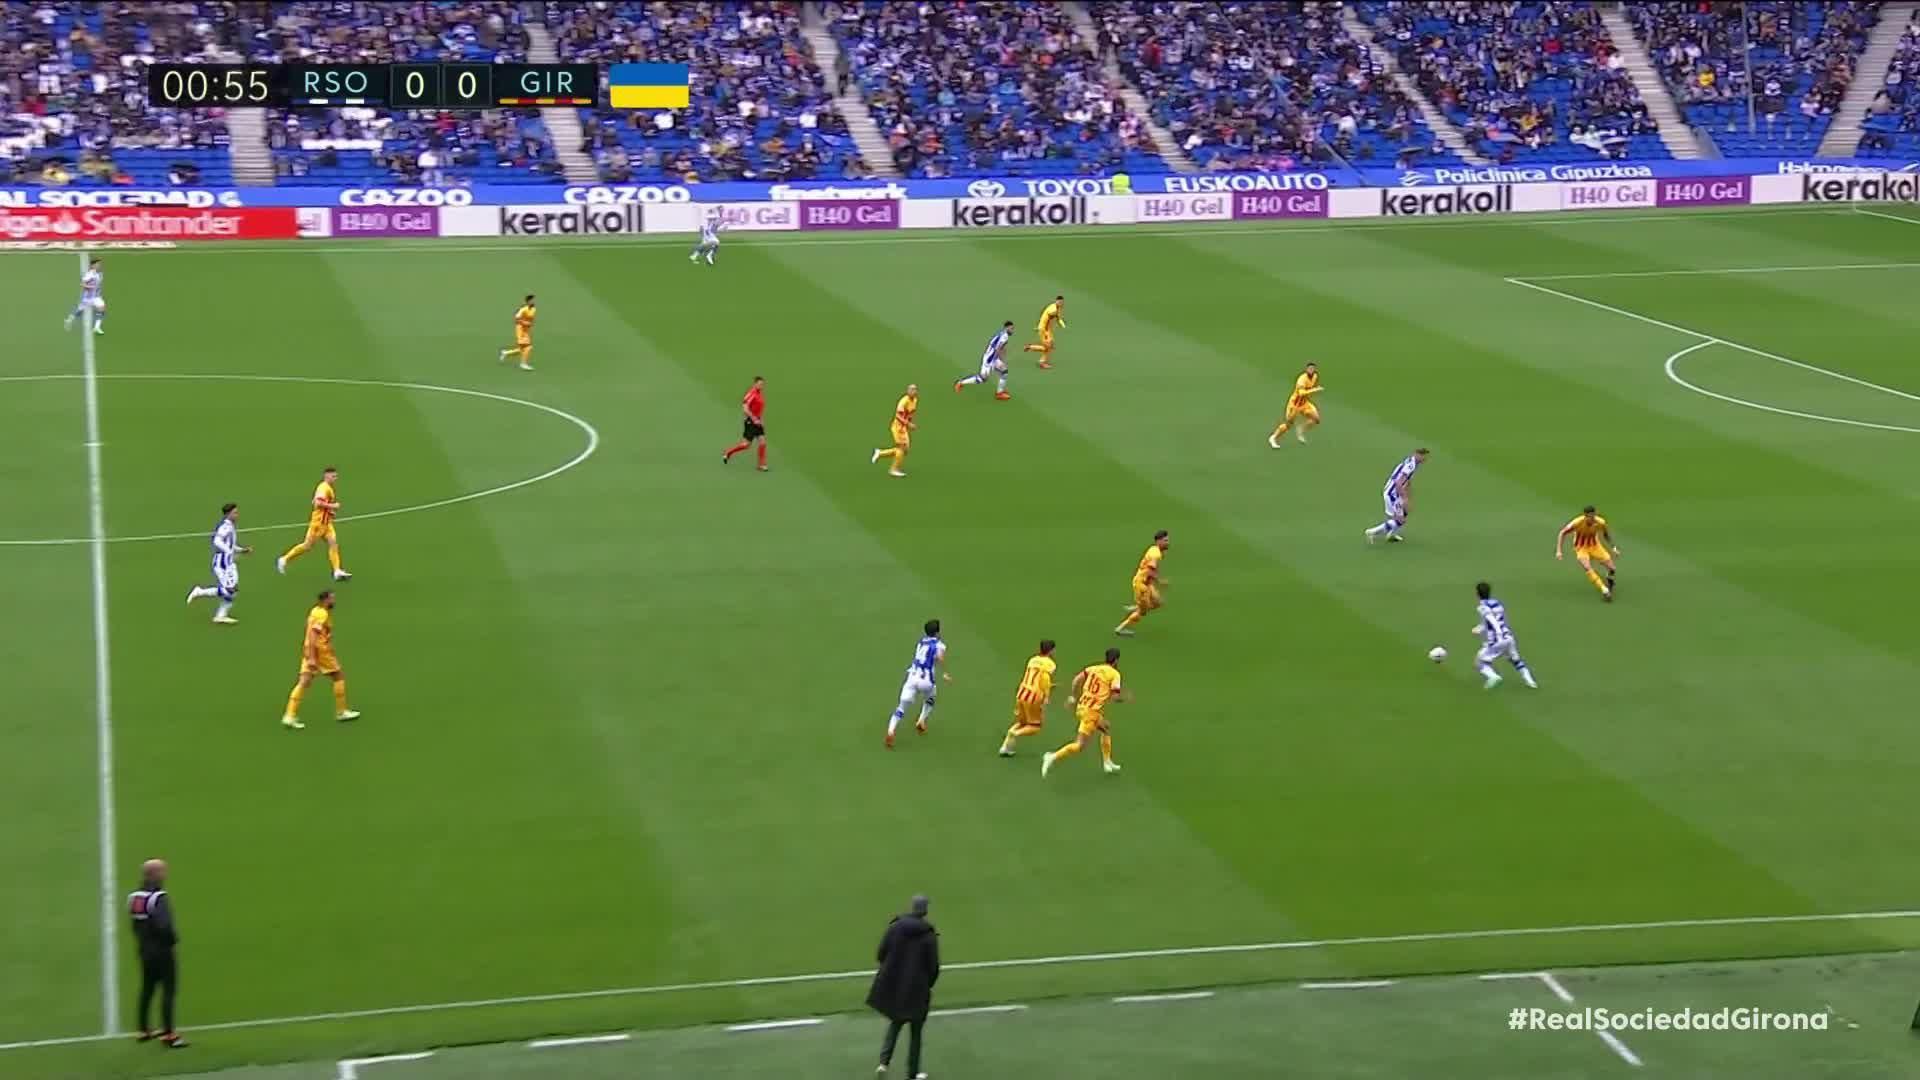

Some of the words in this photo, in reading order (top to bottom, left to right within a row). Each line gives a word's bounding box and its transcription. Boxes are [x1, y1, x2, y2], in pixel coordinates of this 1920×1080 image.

[1022, 179, 1133, 197] TOYOT
[1164, 173, 1328, 193] EUSKOAUTO
[1665, 183, 1704, 200] H40
[1710, 182, 1744, 199] Gel
[1241, 197, 1282, 213] H40
[1288, 196, 1321, 213] Gel
[1381, 185, 1512, 215] kerakoll
[1571, 187, 1609, 204] H40
[1616, 185, 1648, 202] Gel
[501, 205, 644, 235] kerakoll
[952, 197, 1086, 227] kerakoll
[83, 210, 244, 235] Santander
